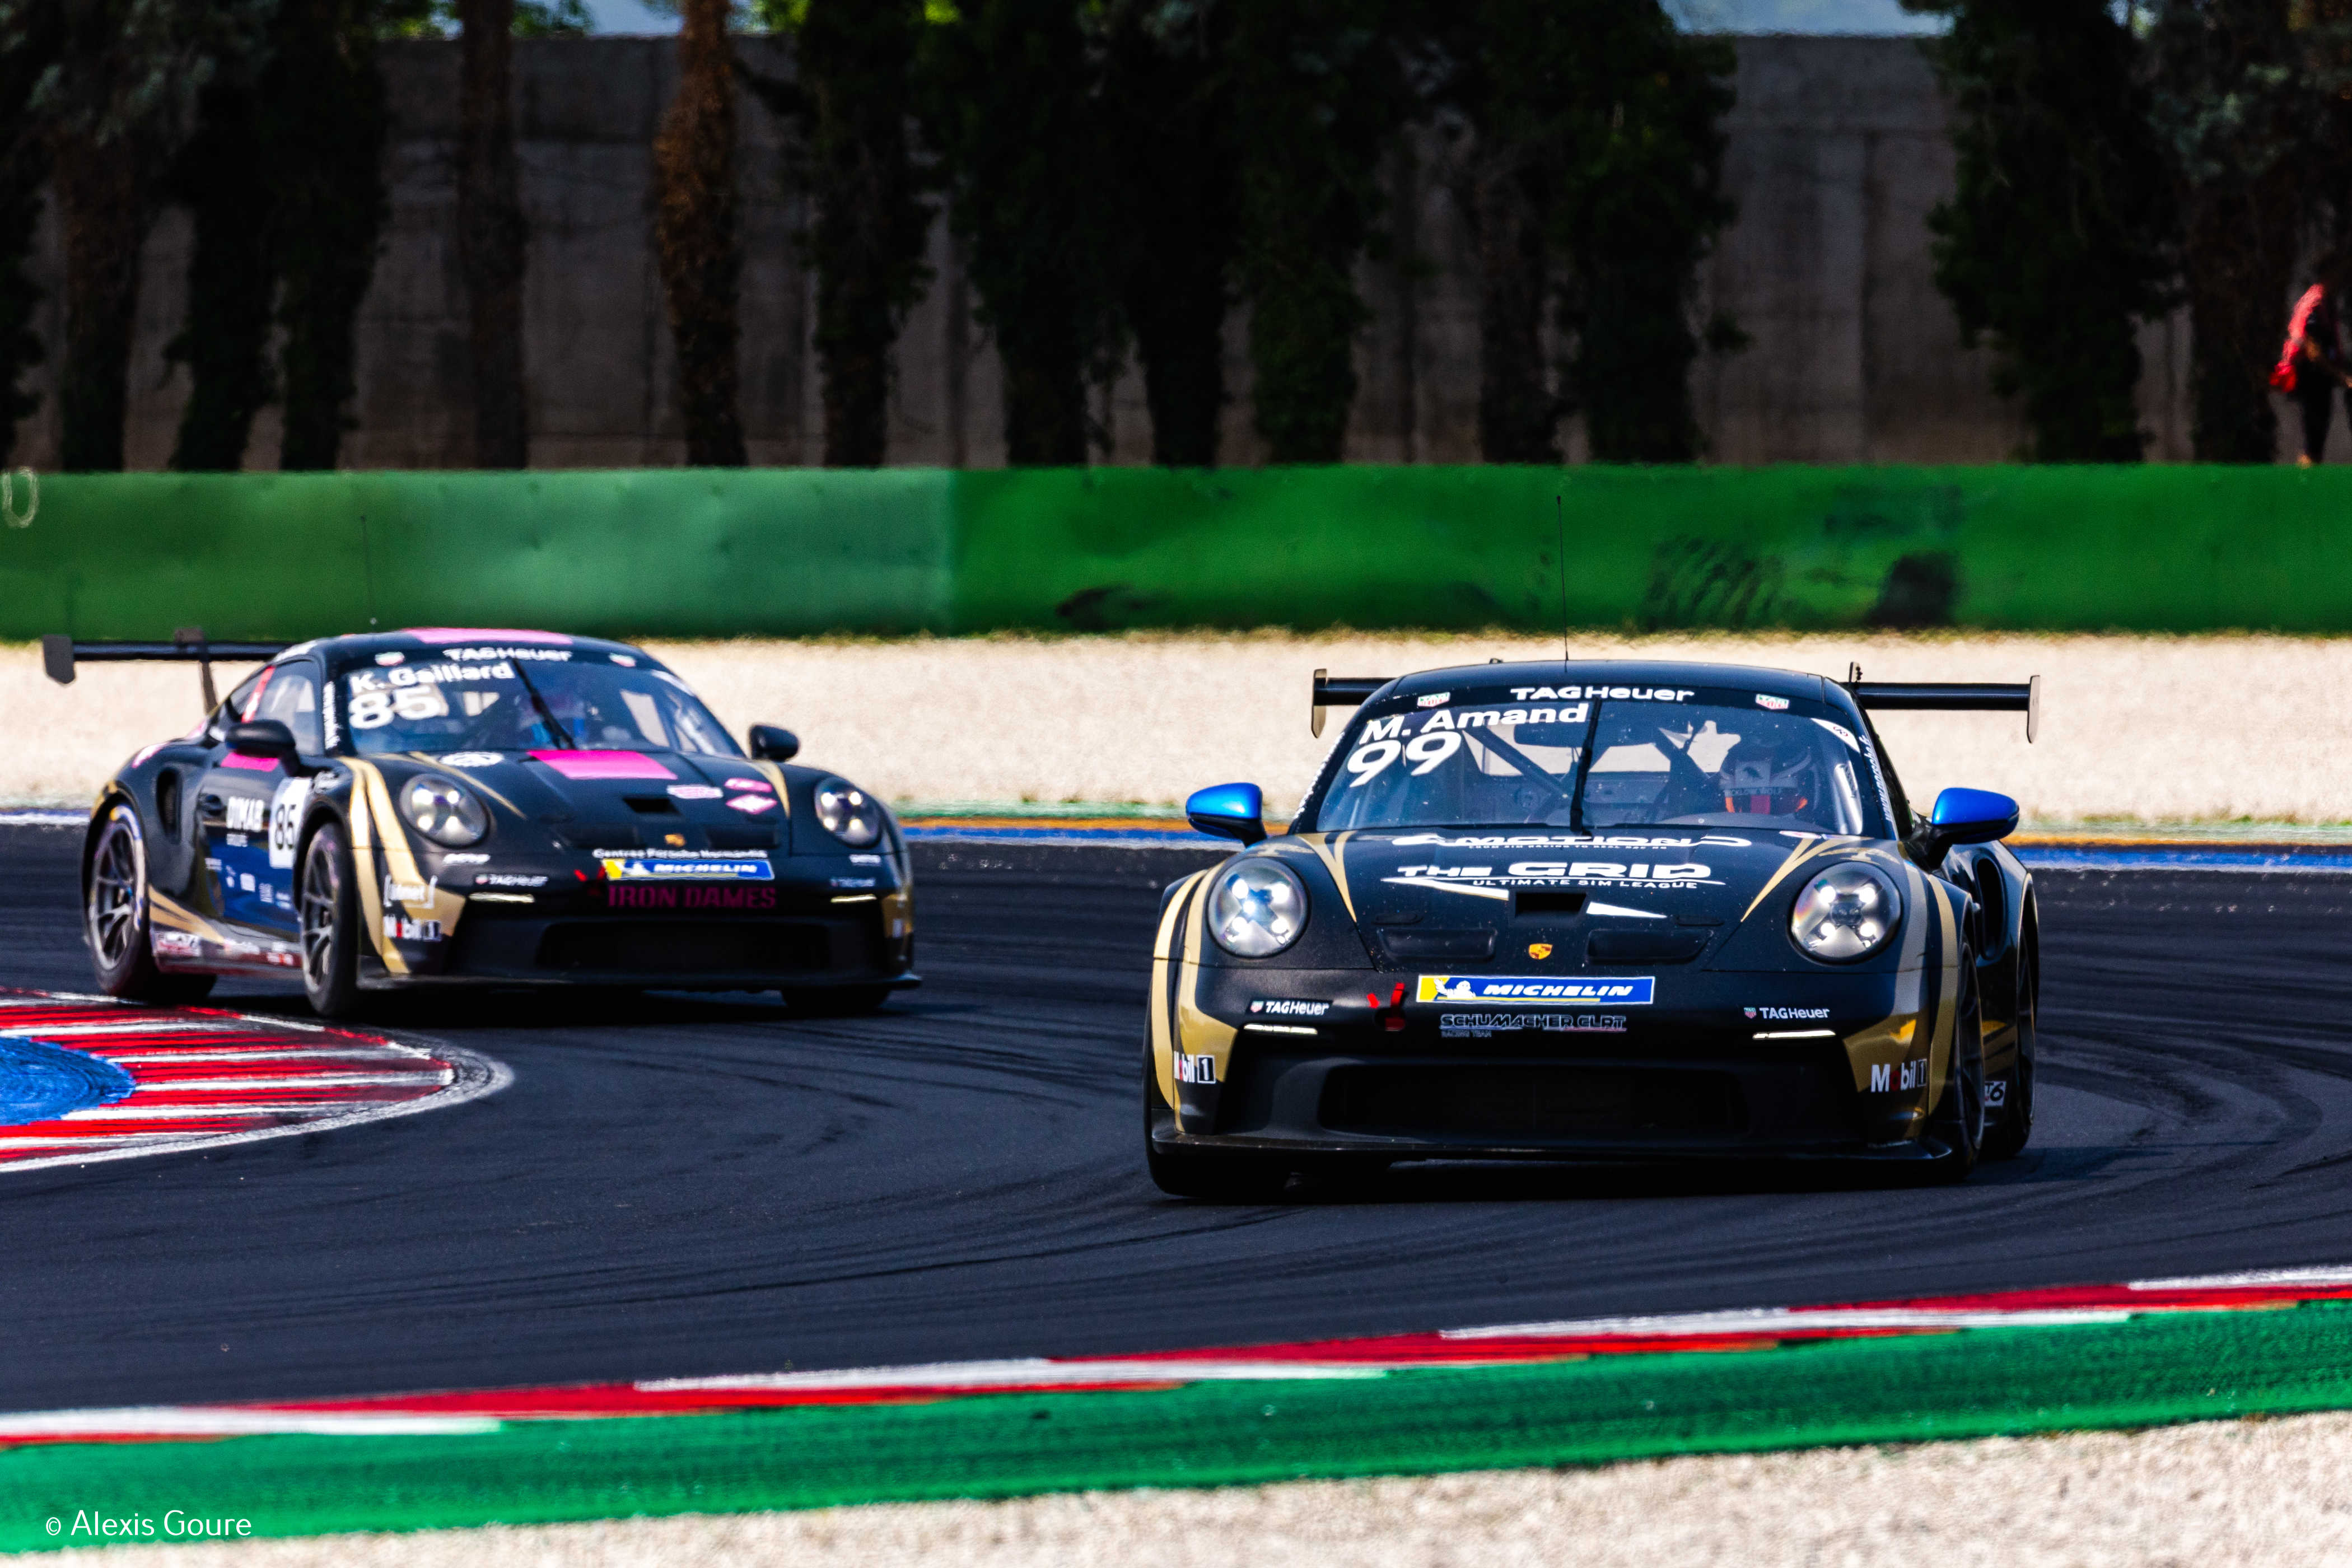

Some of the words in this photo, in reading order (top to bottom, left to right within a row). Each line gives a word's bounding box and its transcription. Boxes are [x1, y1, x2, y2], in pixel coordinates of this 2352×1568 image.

[349, 671, 385, 693] K.
[388, 661, 516, 687] Gaillard
[348, 685, 442, 729] 85
[1359, 715, 1411, 745] M.
[1421, 703, 1589, 734] Amand
[1347, 730, 1462, 787] 99
[274, 803, 296, 850] 85
[654, 864, 757, 874] MICHELIN
[1398, 865, 1492, 877] THE
[1508, 862, 1711, 879] GRID
[607, 884, 676, 908] IRON
[684, 886, 776, 909] DAMES
[1483, 984, 1634, 996] MICHELIN
[1440, 1013, 1575, 1027] SCHUMACHER
[1577, 1014, 1627, 1028] CLRT
[1871, 1061, 1916, 1093] Mobil
